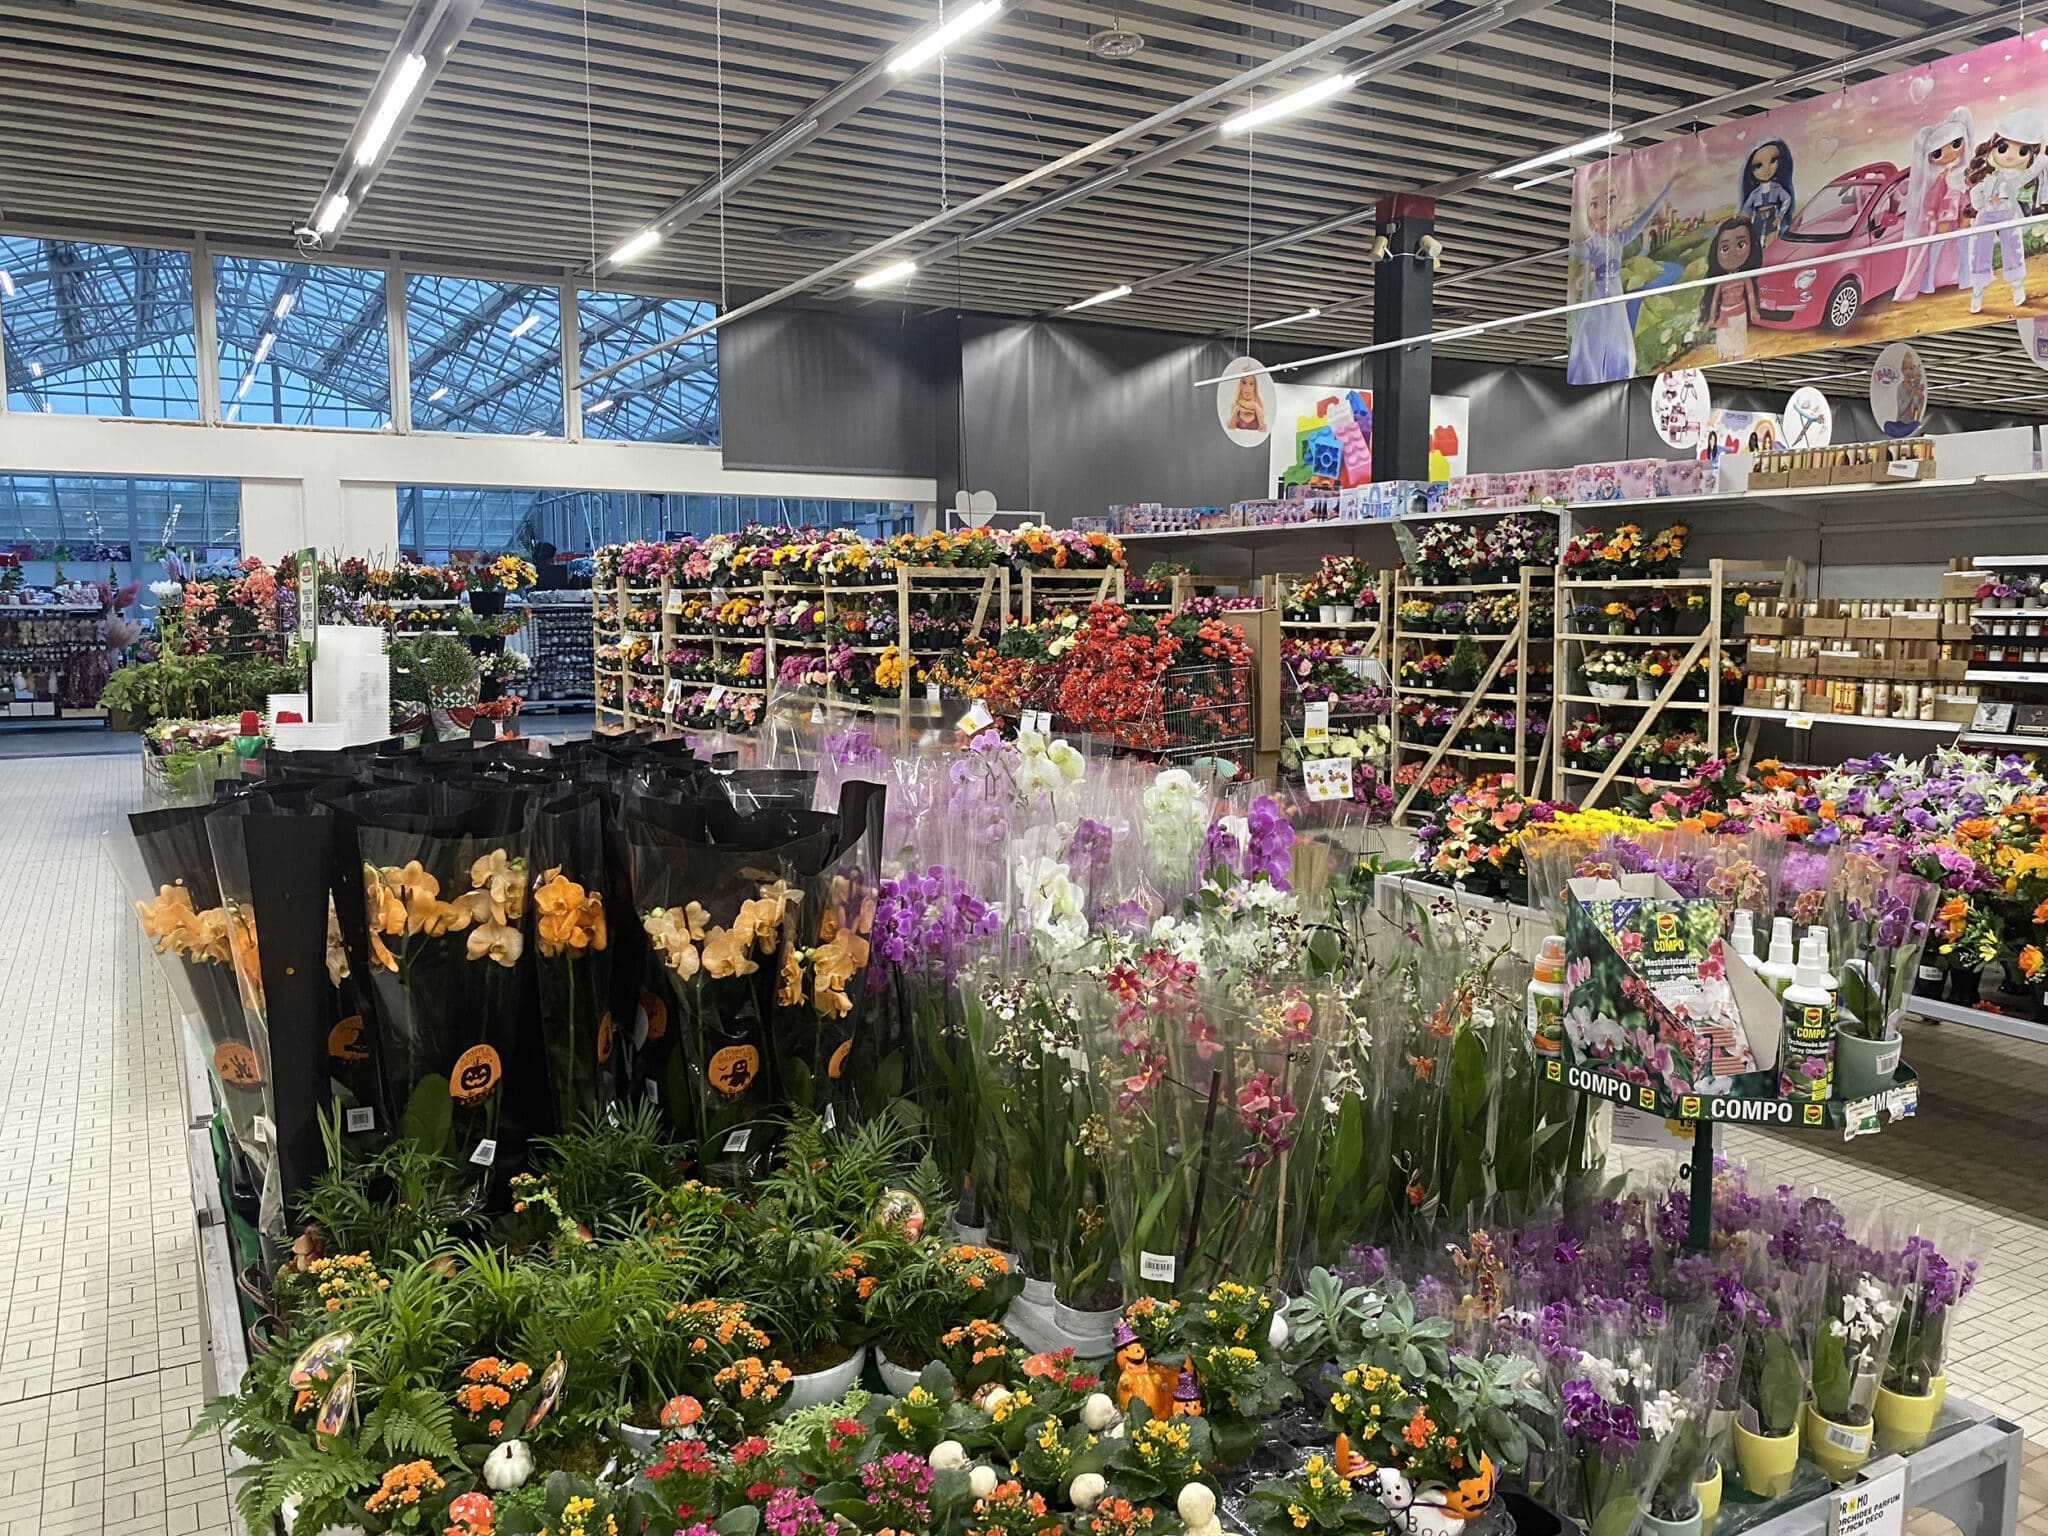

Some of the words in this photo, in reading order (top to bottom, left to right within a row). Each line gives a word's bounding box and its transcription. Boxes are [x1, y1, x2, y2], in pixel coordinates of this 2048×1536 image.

[1654, 940, 1685, 952] COMPO
[1796, 1027, 1826, 1038] COMPO
[1569, 1068, 1631, 1101] COMPO
[1711, 1098, 1793, 1122] COMPO
[1874, 1493, 1900, 1512] PARFUM
[1865, 1511, 1884, 1525] DECO
